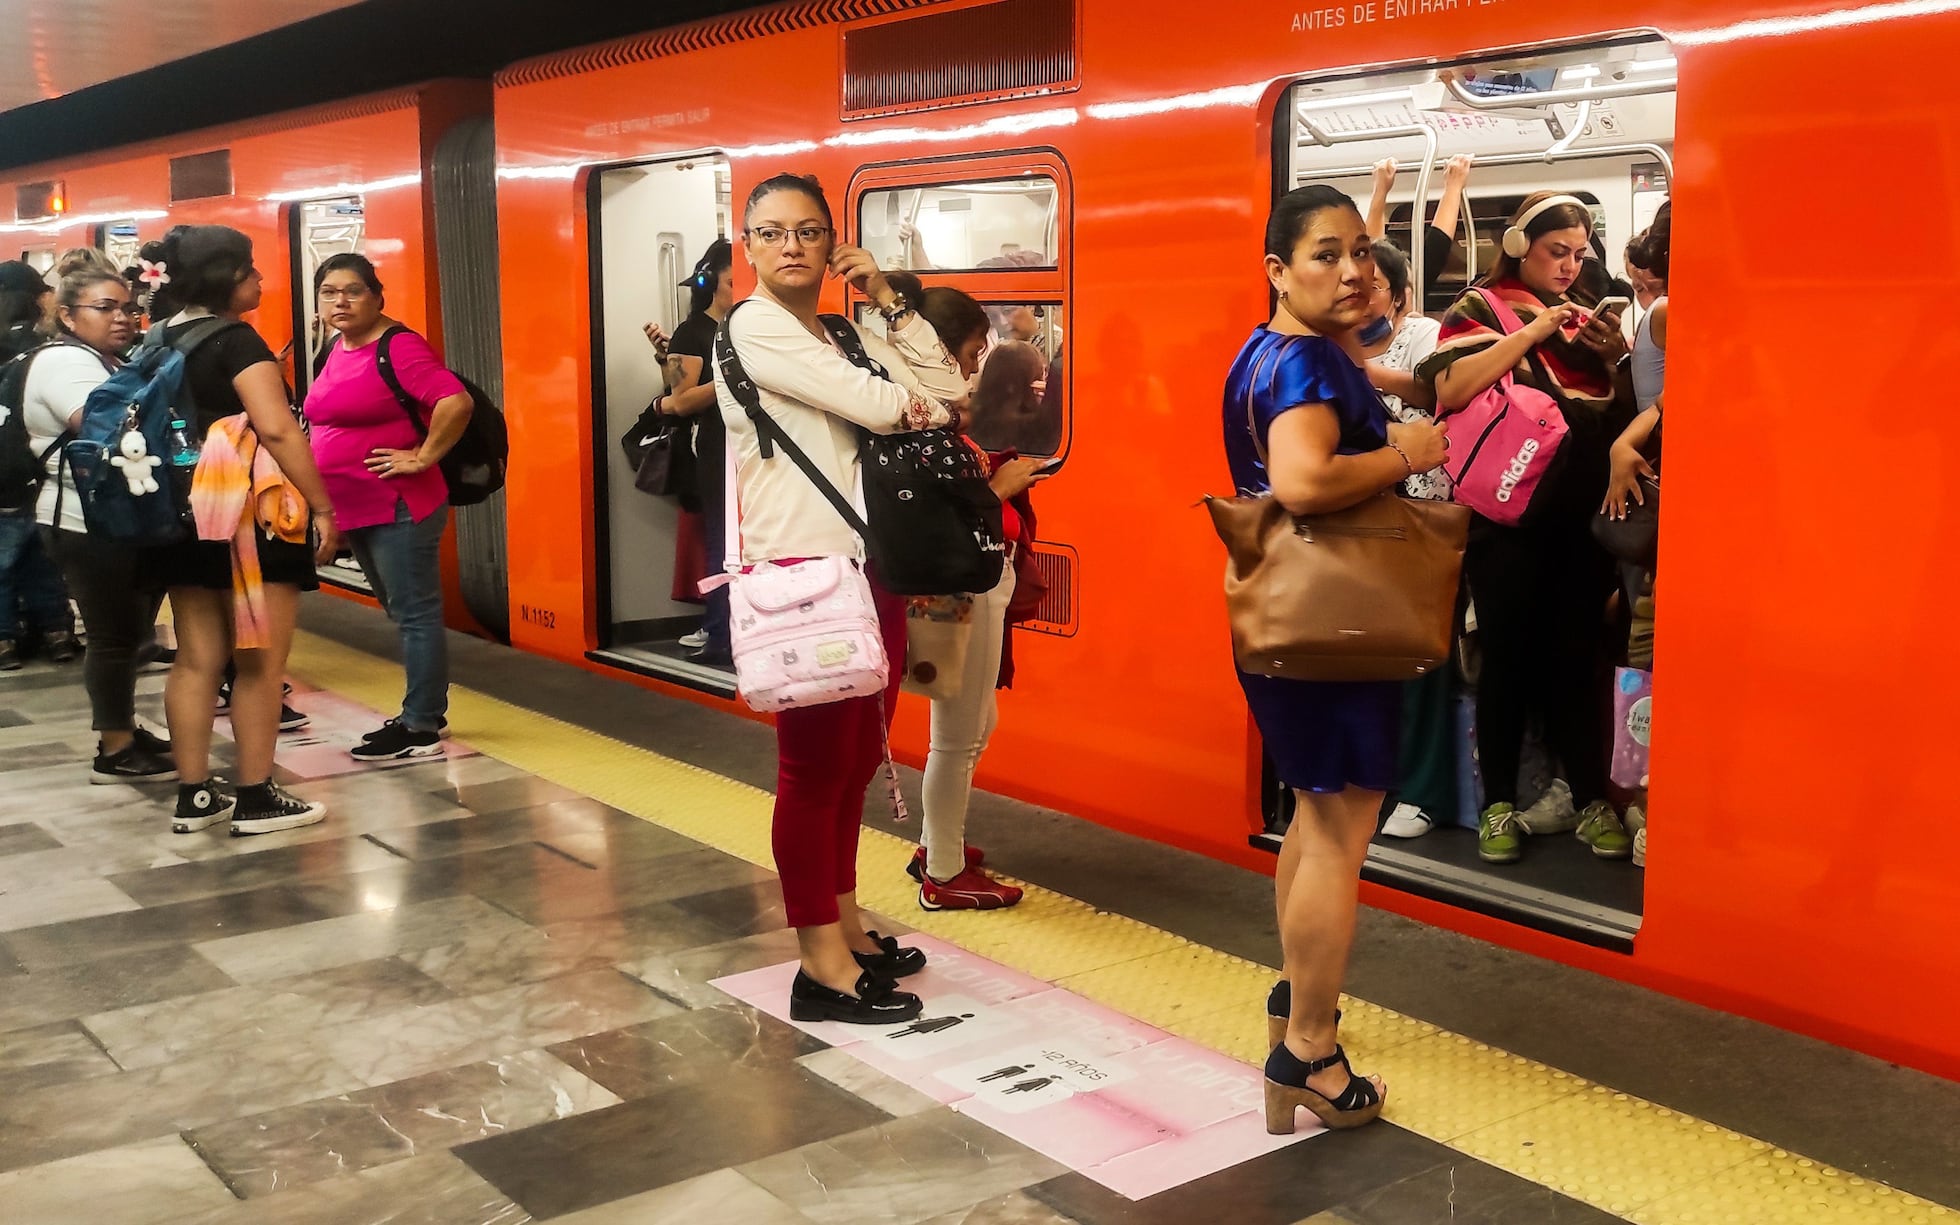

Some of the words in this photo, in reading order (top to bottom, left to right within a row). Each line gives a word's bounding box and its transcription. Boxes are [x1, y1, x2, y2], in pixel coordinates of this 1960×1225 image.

[1290, 8, 1345, 33] ANTES
[1353, 3, 1377, 24] DE
[1496, 438, 1540, 503] adidas
[1058, 1059, 1109, 1081] AÑOS
[1166, 1061, 1265, 1107] NIÑO
